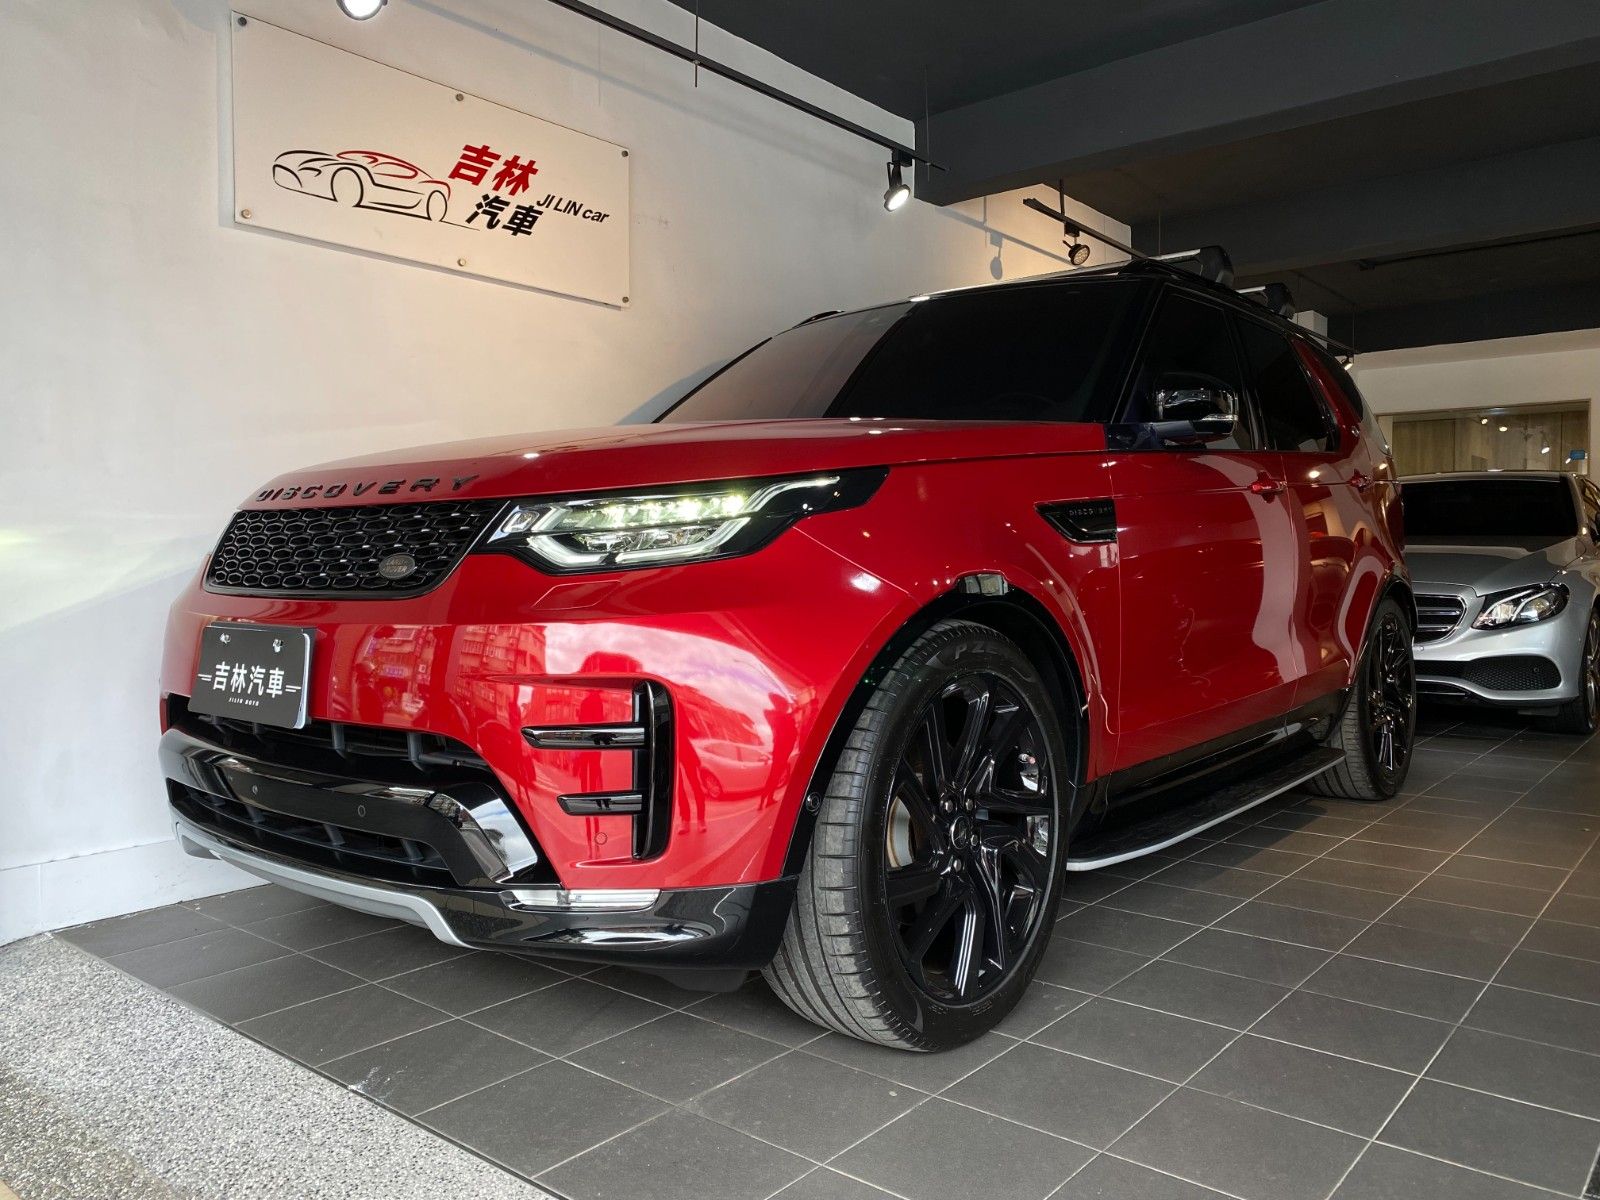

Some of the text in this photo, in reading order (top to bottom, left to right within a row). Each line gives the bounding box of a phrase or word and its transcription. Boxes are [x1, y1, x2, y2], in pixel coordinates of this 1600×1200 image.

[448, 144, 539, 196] 吉林
[465, 193, 543, 236] 汽車
[536, 194, 609, 223] JI LIN car
[255, 474, 479, 502] DISCOVERY
[213, 661, 284, 698] 吉林汽車
